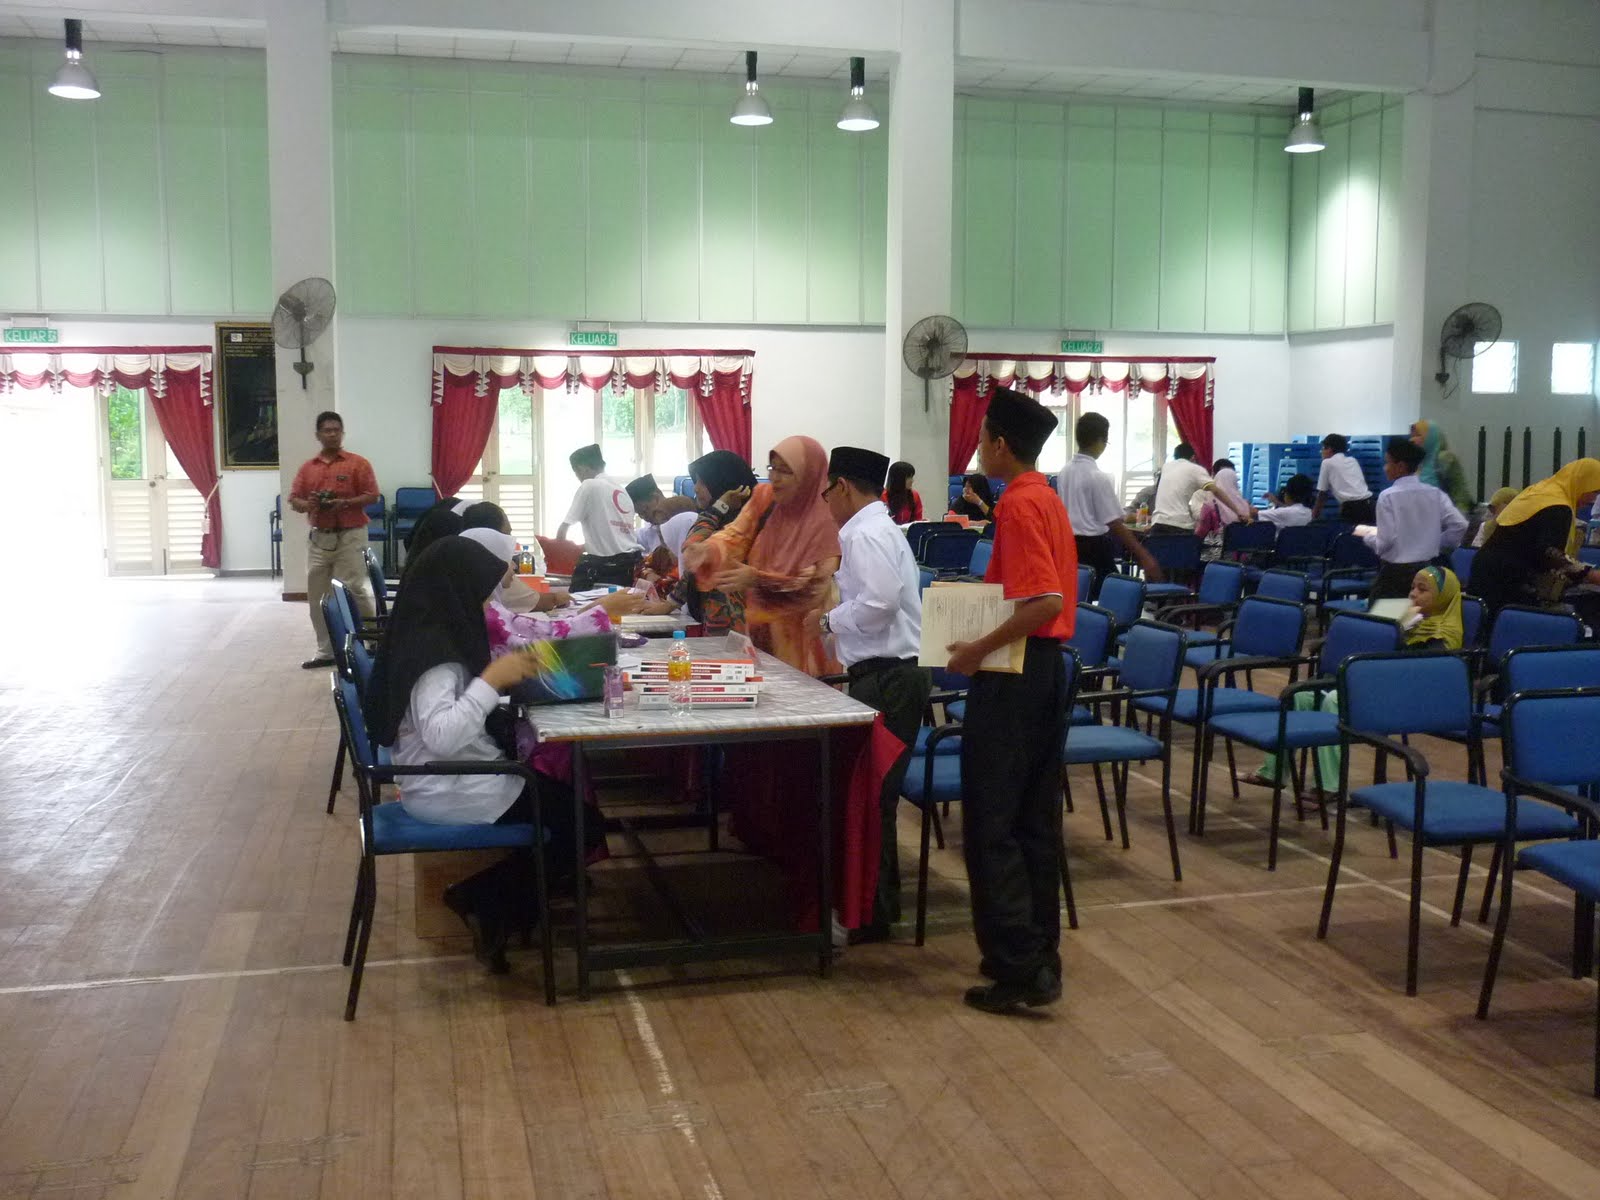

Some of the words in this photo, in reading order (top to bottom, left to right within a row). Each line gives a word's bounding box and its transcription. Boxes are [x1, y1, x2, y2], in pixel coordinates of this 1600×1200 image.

[5, 329, 47, 341] KELUAR
[571, 333, 607, 344] KELUAR
[1062, 341, 1093, 352] KELUAR
